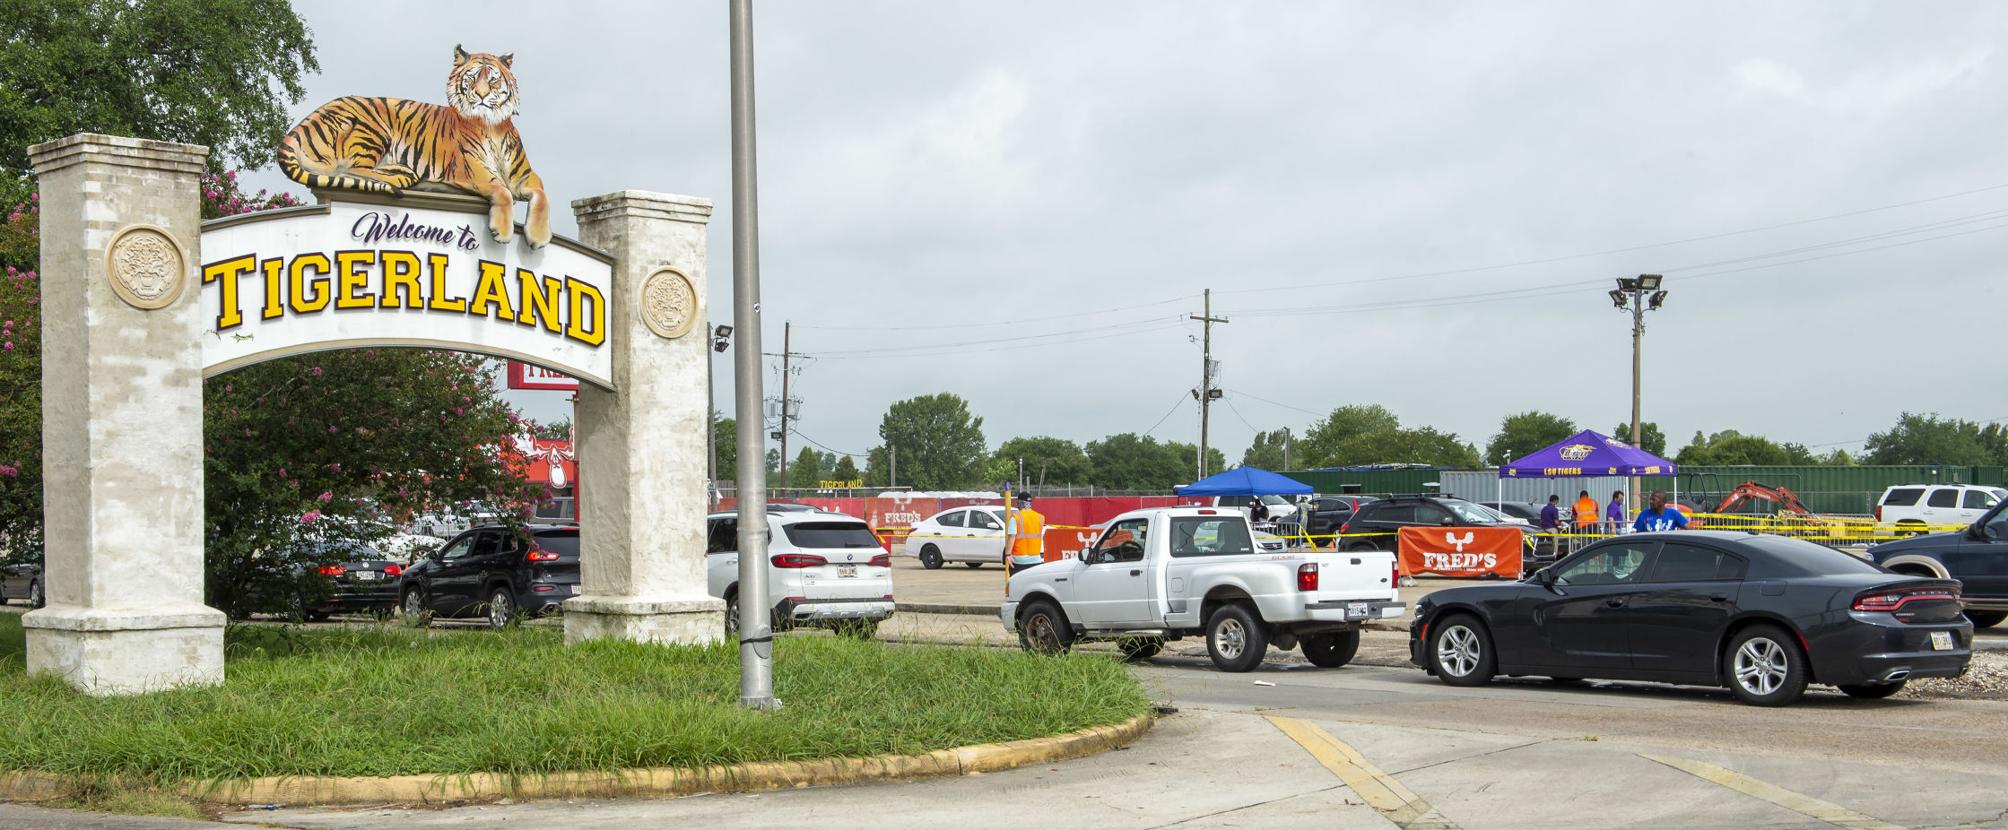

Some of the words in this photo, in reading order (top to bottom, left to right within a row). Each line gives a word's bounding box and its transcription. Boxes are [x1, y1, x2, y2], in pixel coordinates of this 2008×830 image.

[351, 211, 455, 244] Welcome
[456, 223, 480, 251] to
[201, 249, 606, 348] TIGERLAND
[1558, 467, 1582, 476] TIGERS
[820, 479, 864, 489] TIGERLAND
[884, 510, 921, 523] FRED'S
[1423, 552, 1497, 568] FRED'S
